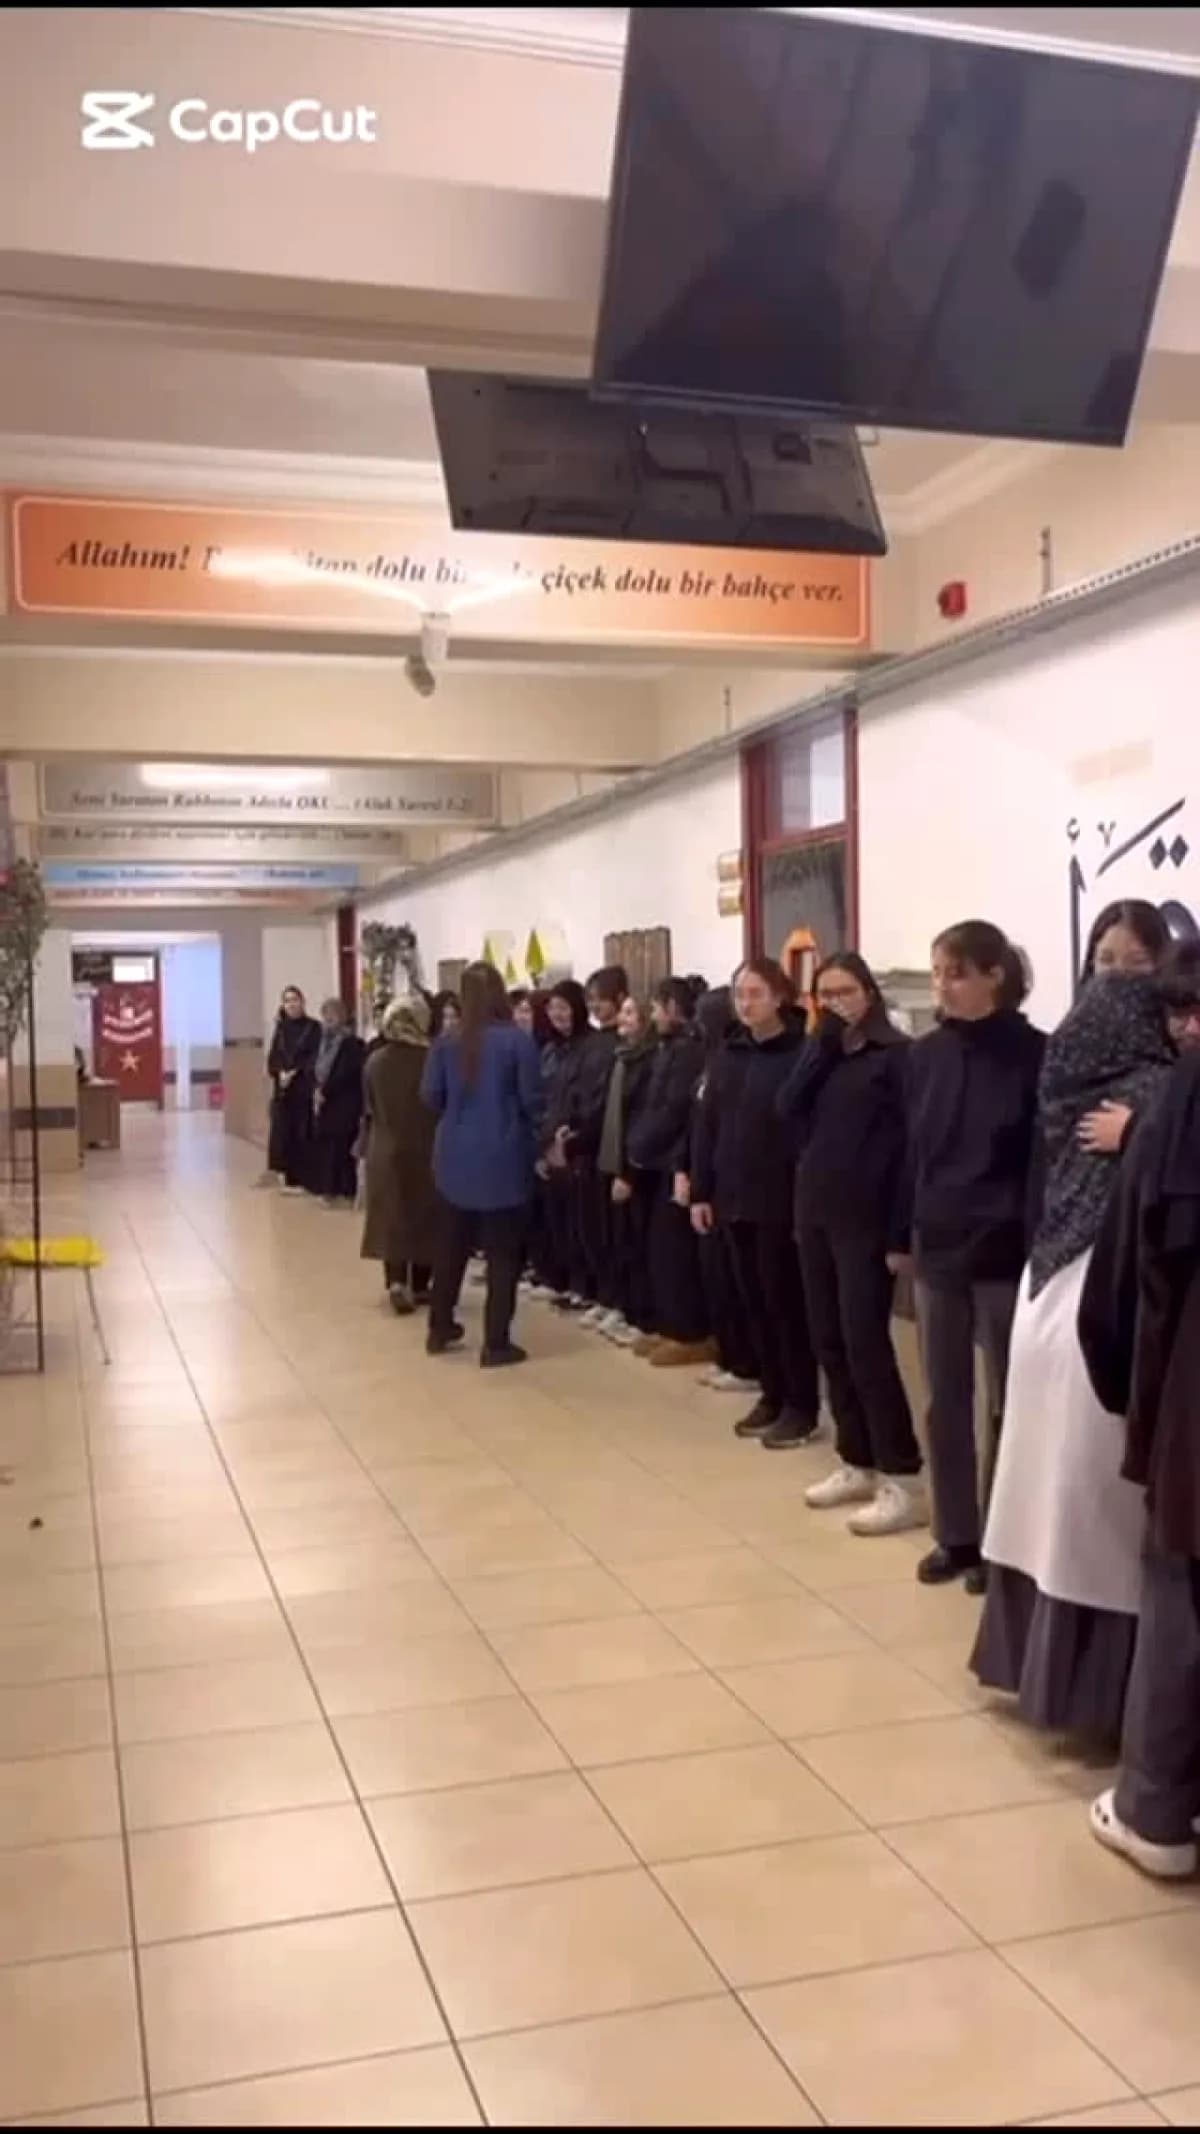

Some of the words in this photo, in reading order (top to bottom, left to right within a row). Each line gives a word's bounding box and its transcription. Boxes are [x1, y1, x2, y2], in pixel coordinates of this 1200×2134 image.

[56, 539, 191, 572] Allahım!
[366, 554, 427, 582] dolu
[435, 556, 468, 584] bi
[541, 564, 606, 594] çiçek
[614, 566, 671, 595] dolu
[679, 569, 713, 597] bir
[722, 572, 796, 604] bahçe
[801, 580, 845, 602] ver.
